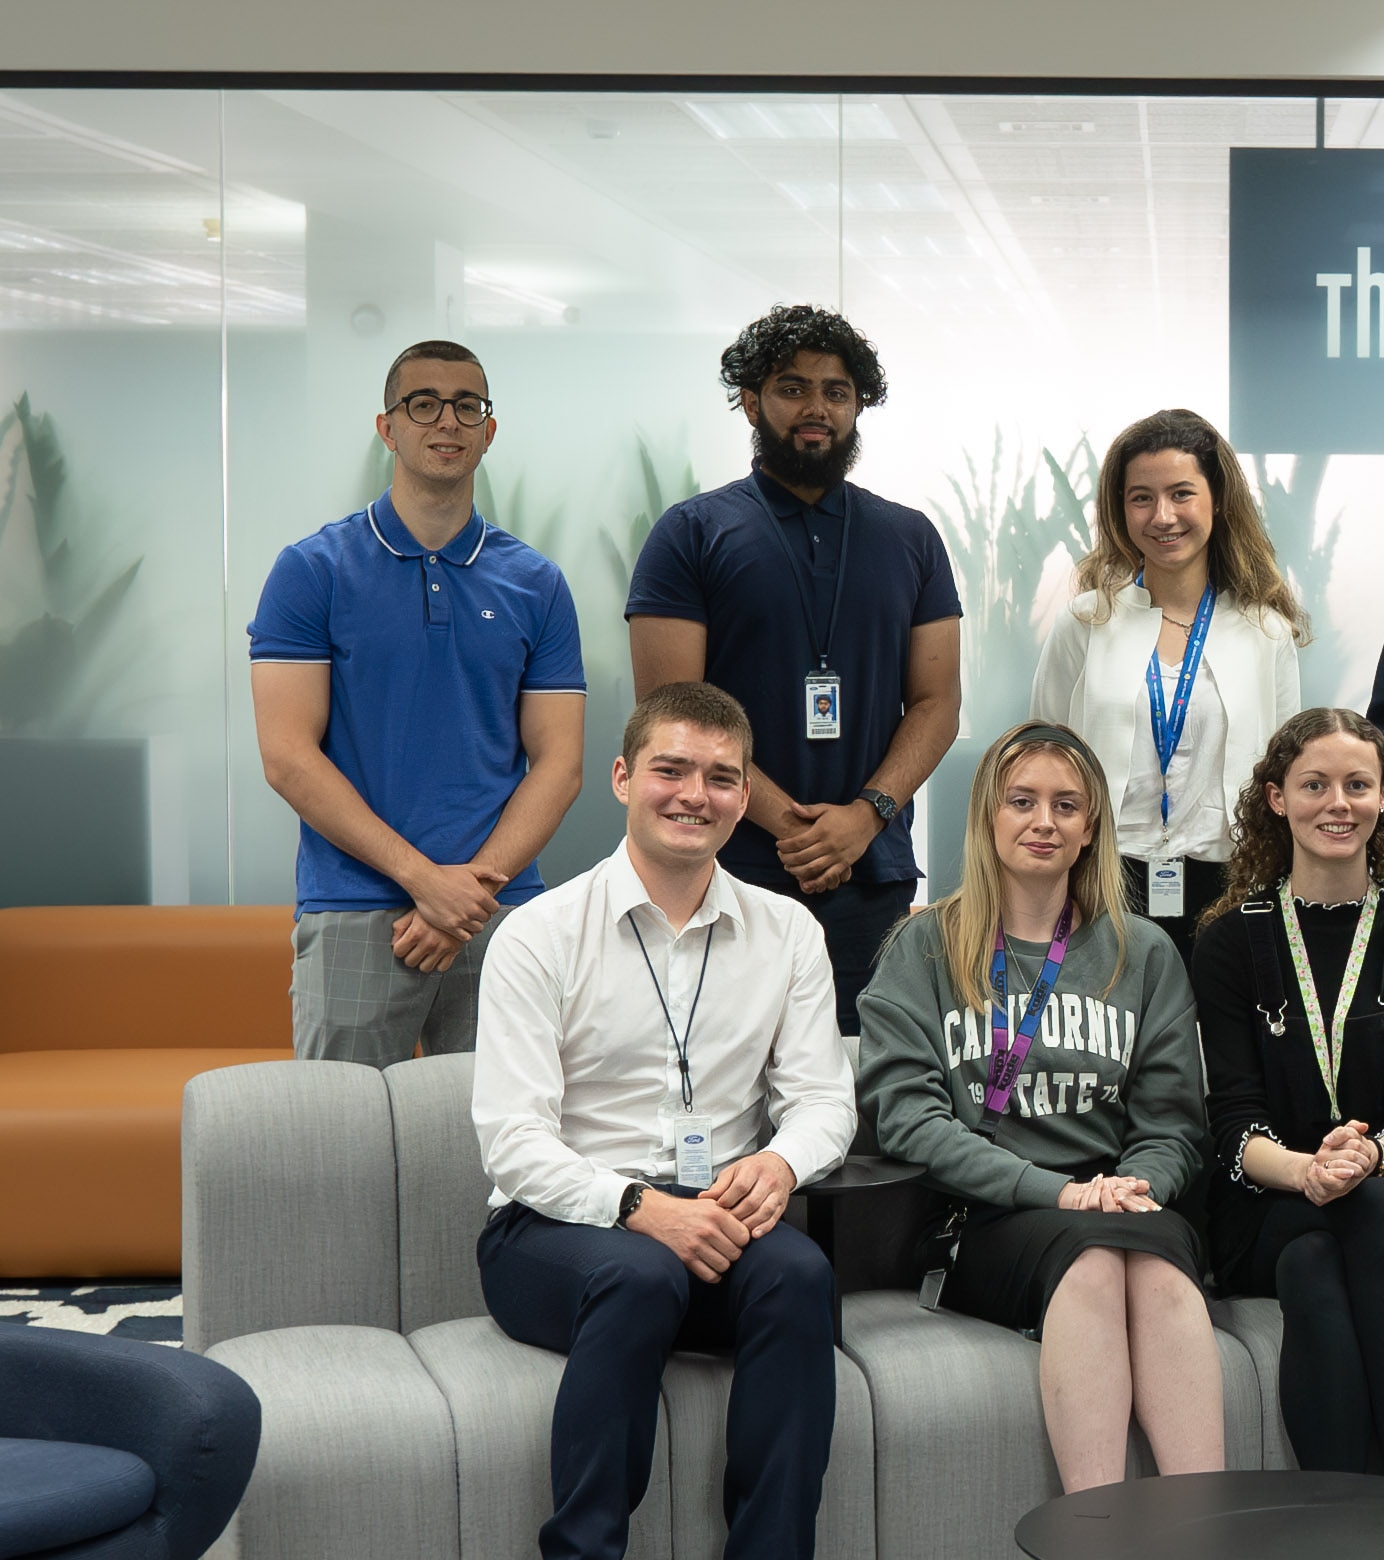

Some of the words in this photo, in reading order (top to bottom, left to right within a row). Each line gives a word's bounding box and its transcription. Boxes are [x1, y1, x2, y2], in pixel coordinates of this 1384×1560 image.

[968, 1082, 985, 1105] 19
[1001, 1072, 1098, 1117] TATE
[1100, 1085, 1119, 1103] 72
